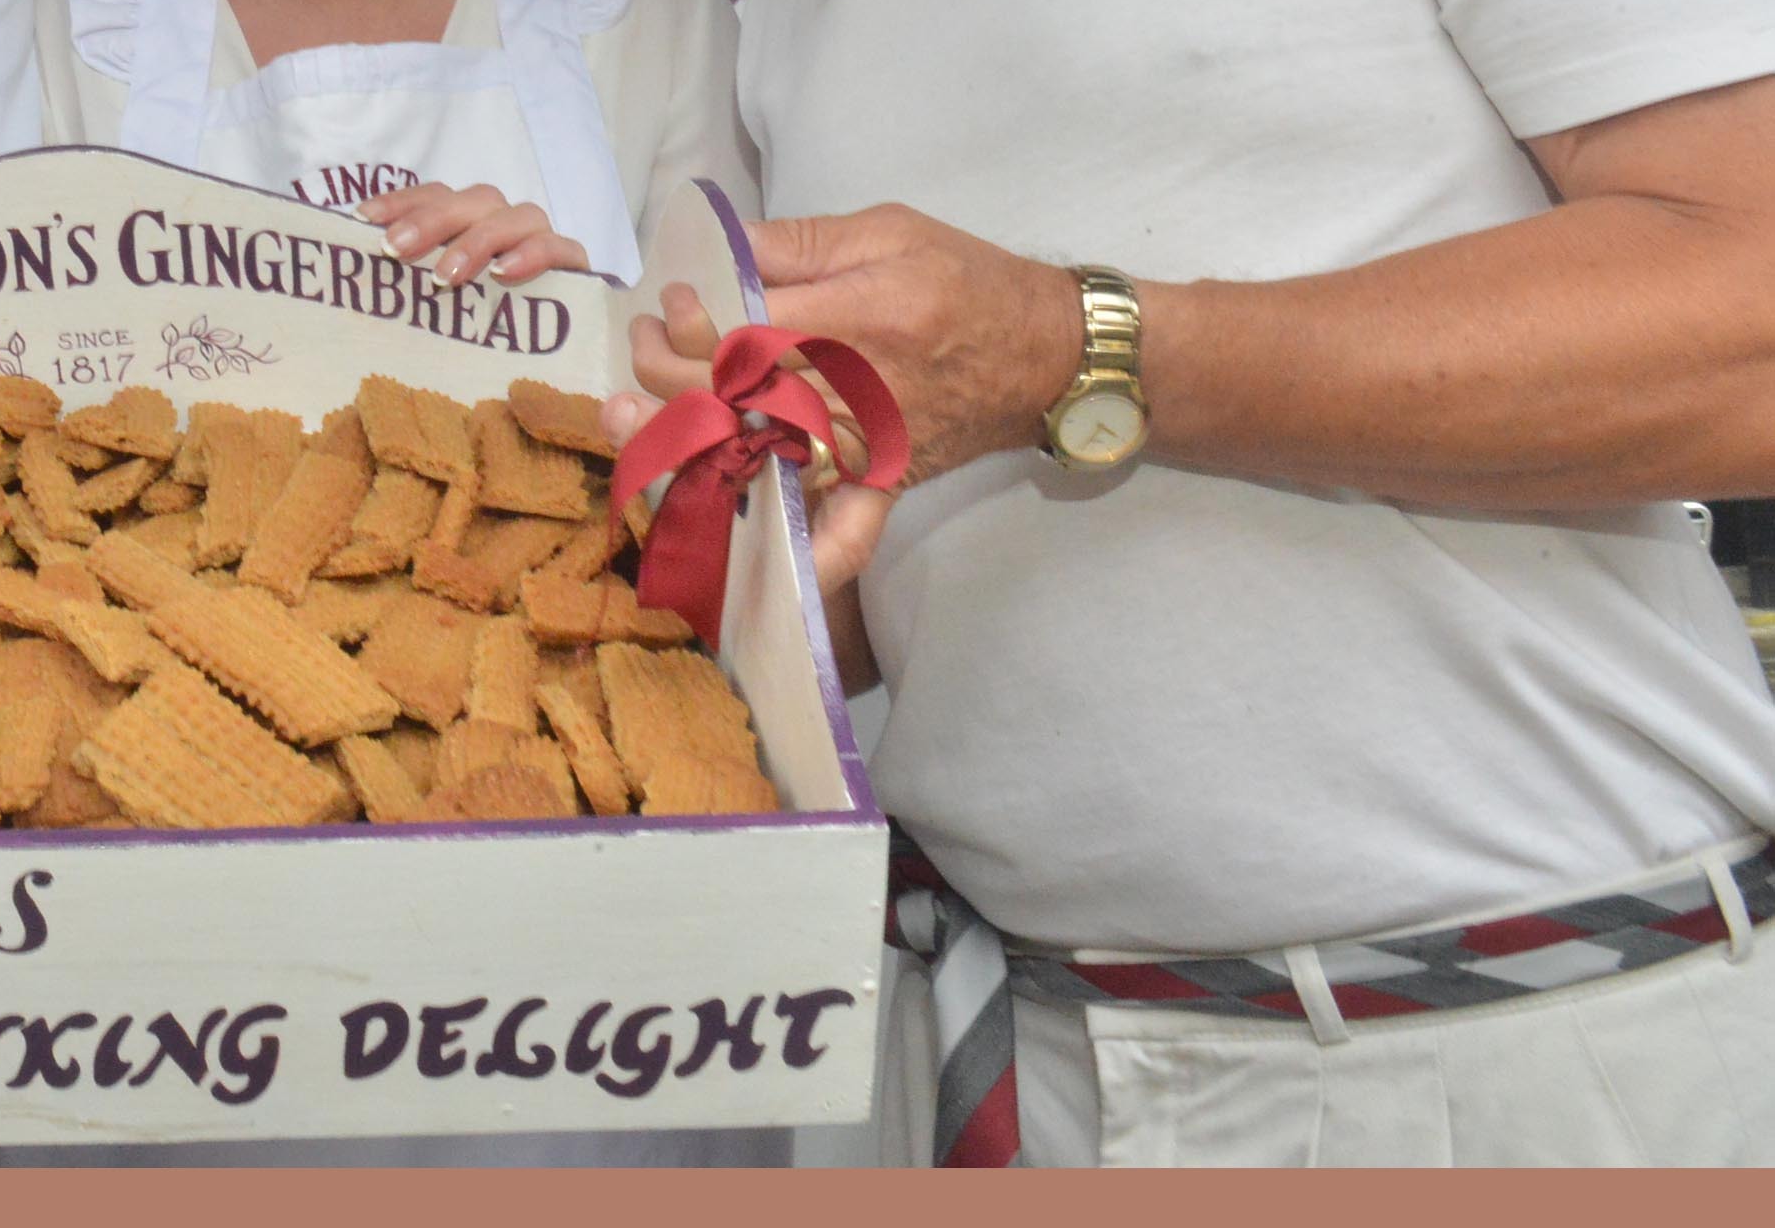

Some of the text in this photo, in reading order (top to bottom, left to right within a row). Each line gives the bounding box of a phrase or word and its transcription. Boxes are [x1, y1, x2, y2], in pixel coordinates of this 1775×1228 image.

[117, 209, 571, 354] GINGERBREAD
[51, 353, 135, 385] 1817
[57, 329, 134, 350] SINCE
[339, 988, 856, 1099] DELIGHT
